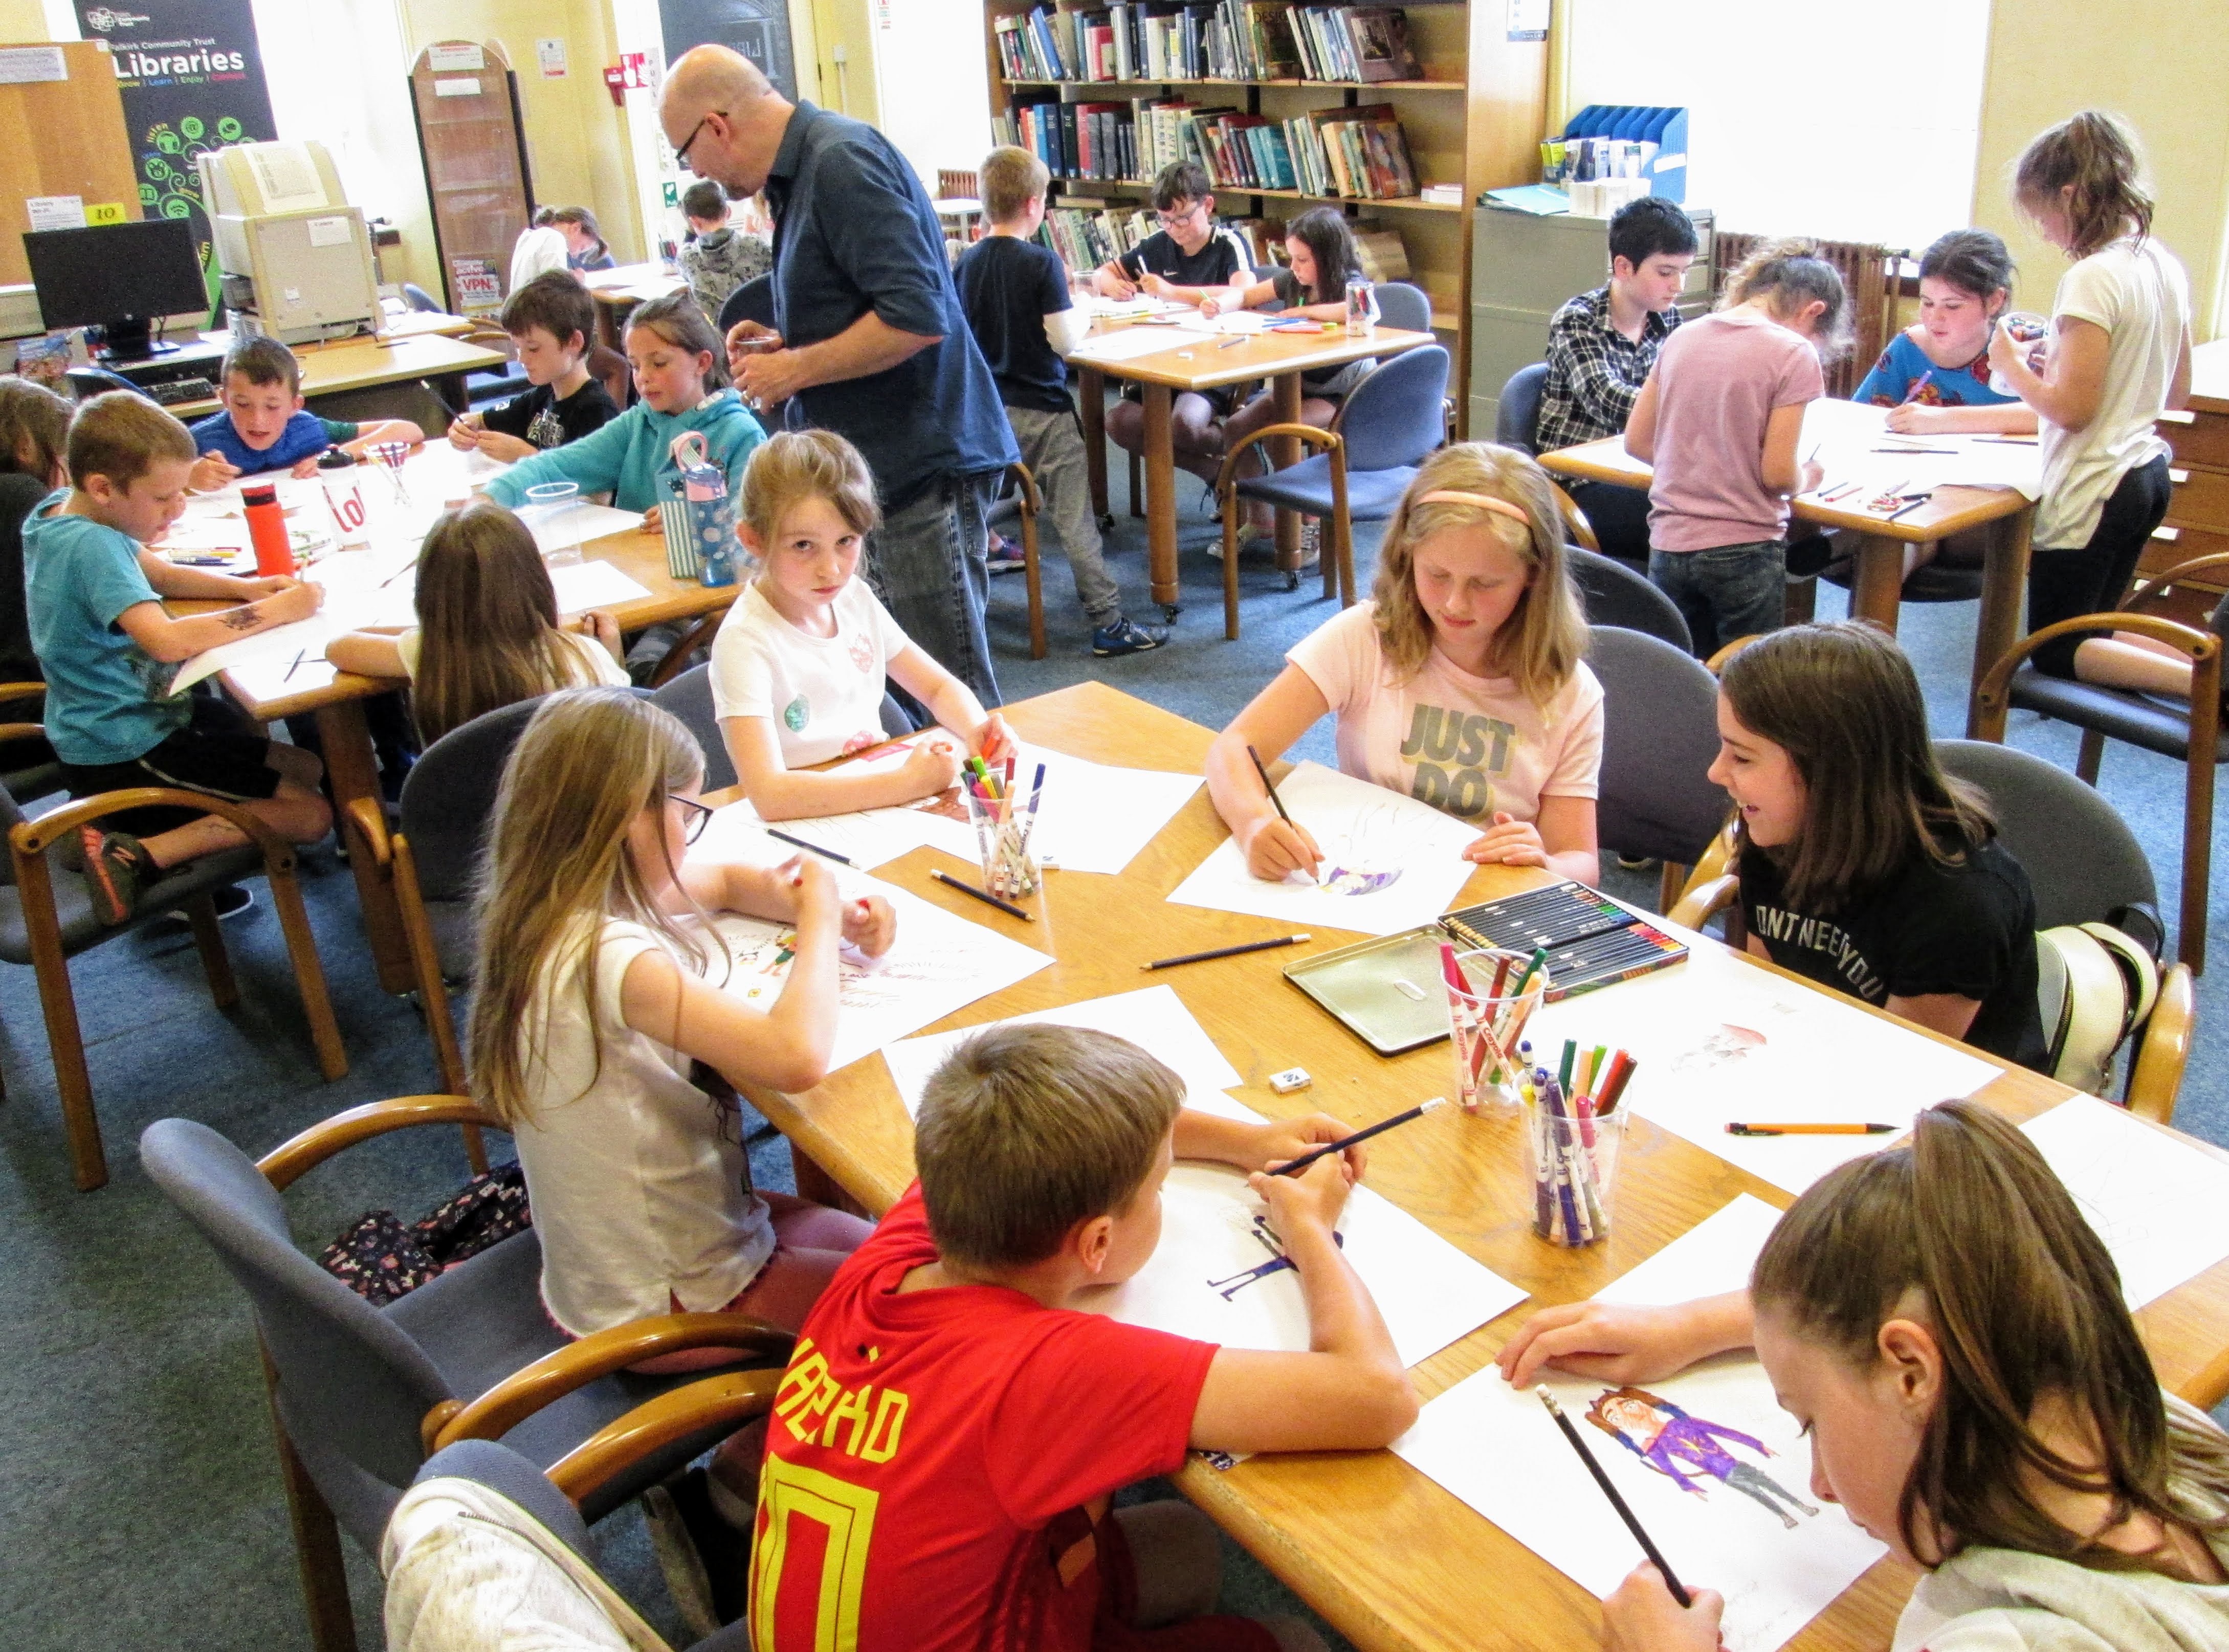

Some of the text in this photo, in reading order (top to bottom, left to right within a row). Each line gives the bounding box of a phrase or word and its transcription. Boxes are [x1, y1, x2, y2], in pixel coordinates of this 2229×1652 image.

[141, 39, 191, 50] Community
[192, 38, 217, 46] Trust
[112, 49, 245, 78] Libraries
[1400, 703, 1516, 773] JUST
[1411, 761, 1489, 817] DO
[1483, 1027, 1504, 1059] Crayola
